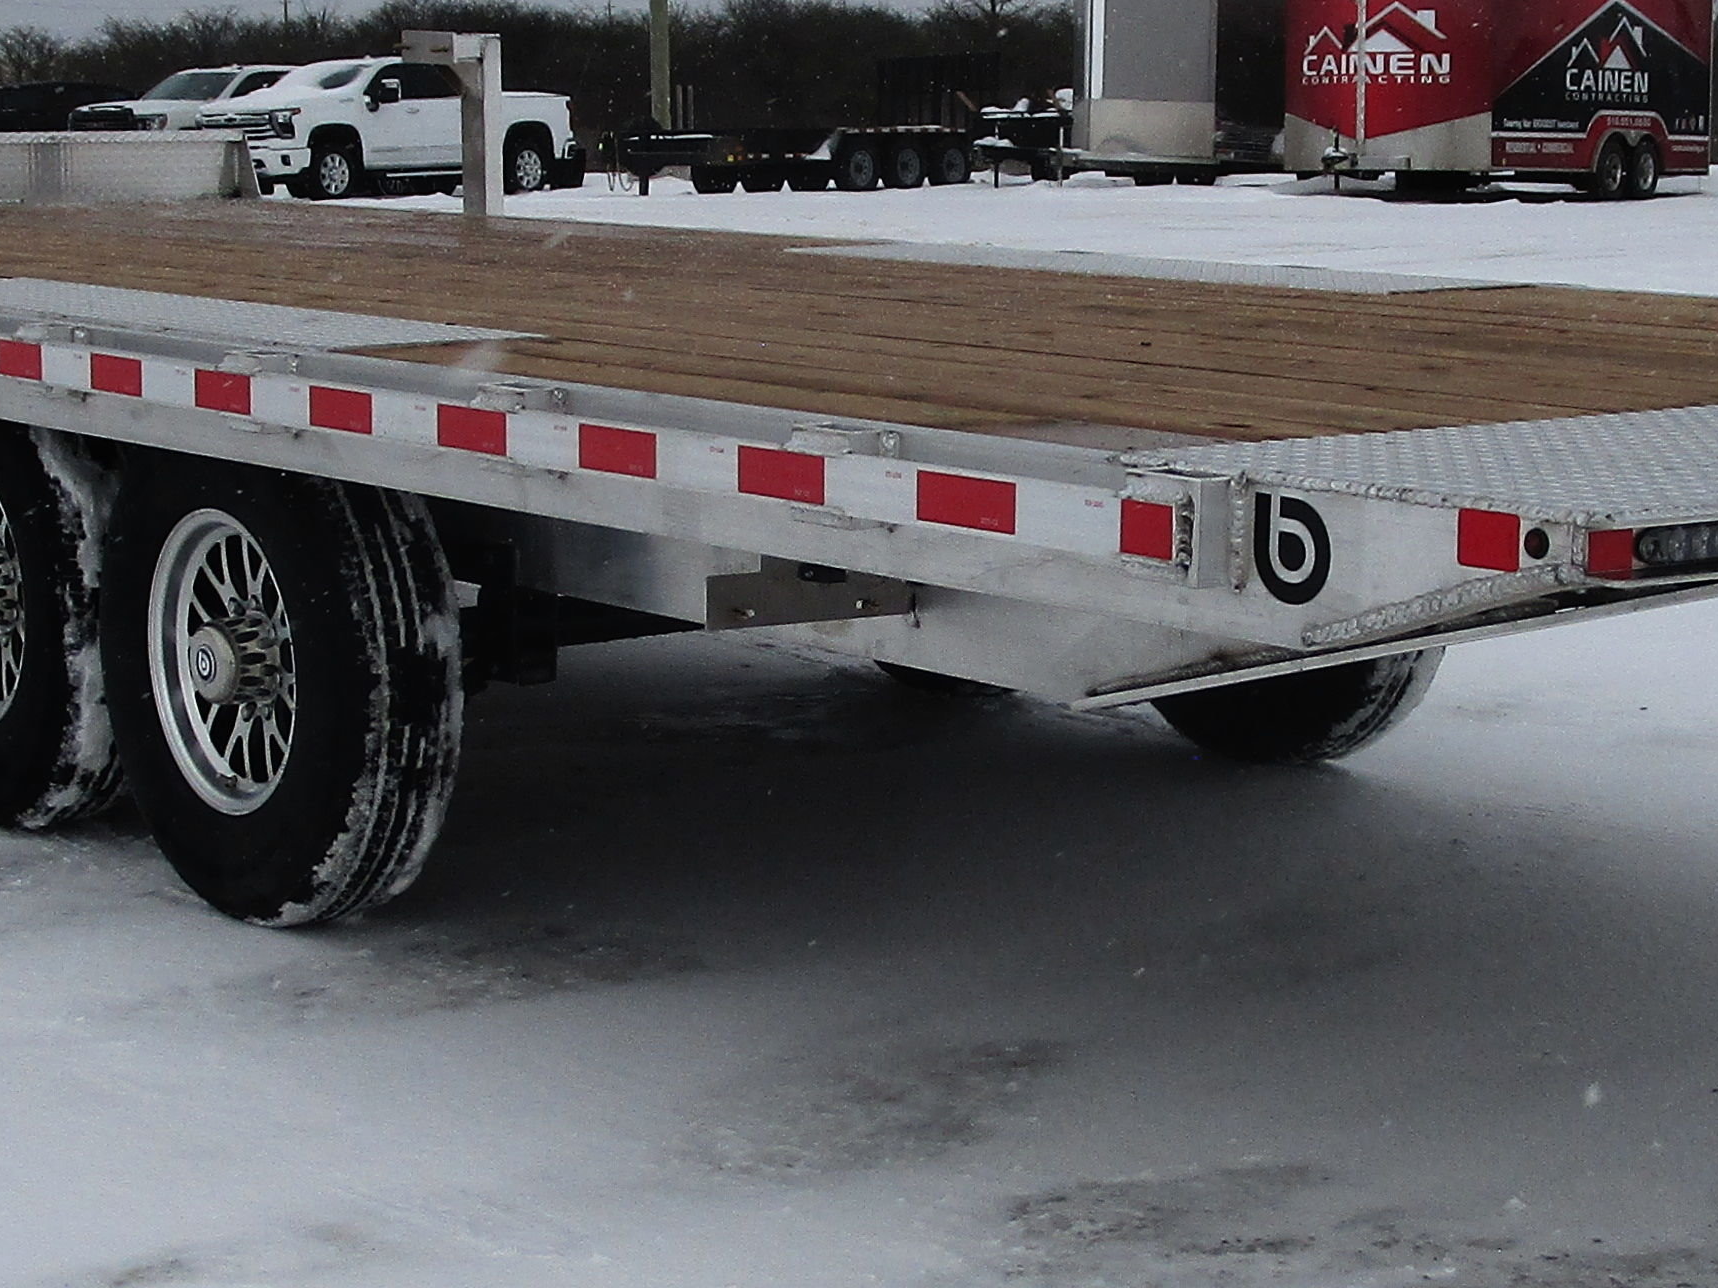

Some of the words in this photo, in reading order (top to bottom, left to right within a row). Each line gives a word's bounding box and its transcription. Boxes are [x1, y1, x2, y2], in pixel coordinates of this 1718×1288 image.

[1302, 53, 1451, 76] CAINEN
[1302, 75, 1451, 84] CONTRACTING
[1565, 68, 1649, 93] CAINEN
[1565, 92, 1649, 104] CONTRACTING
